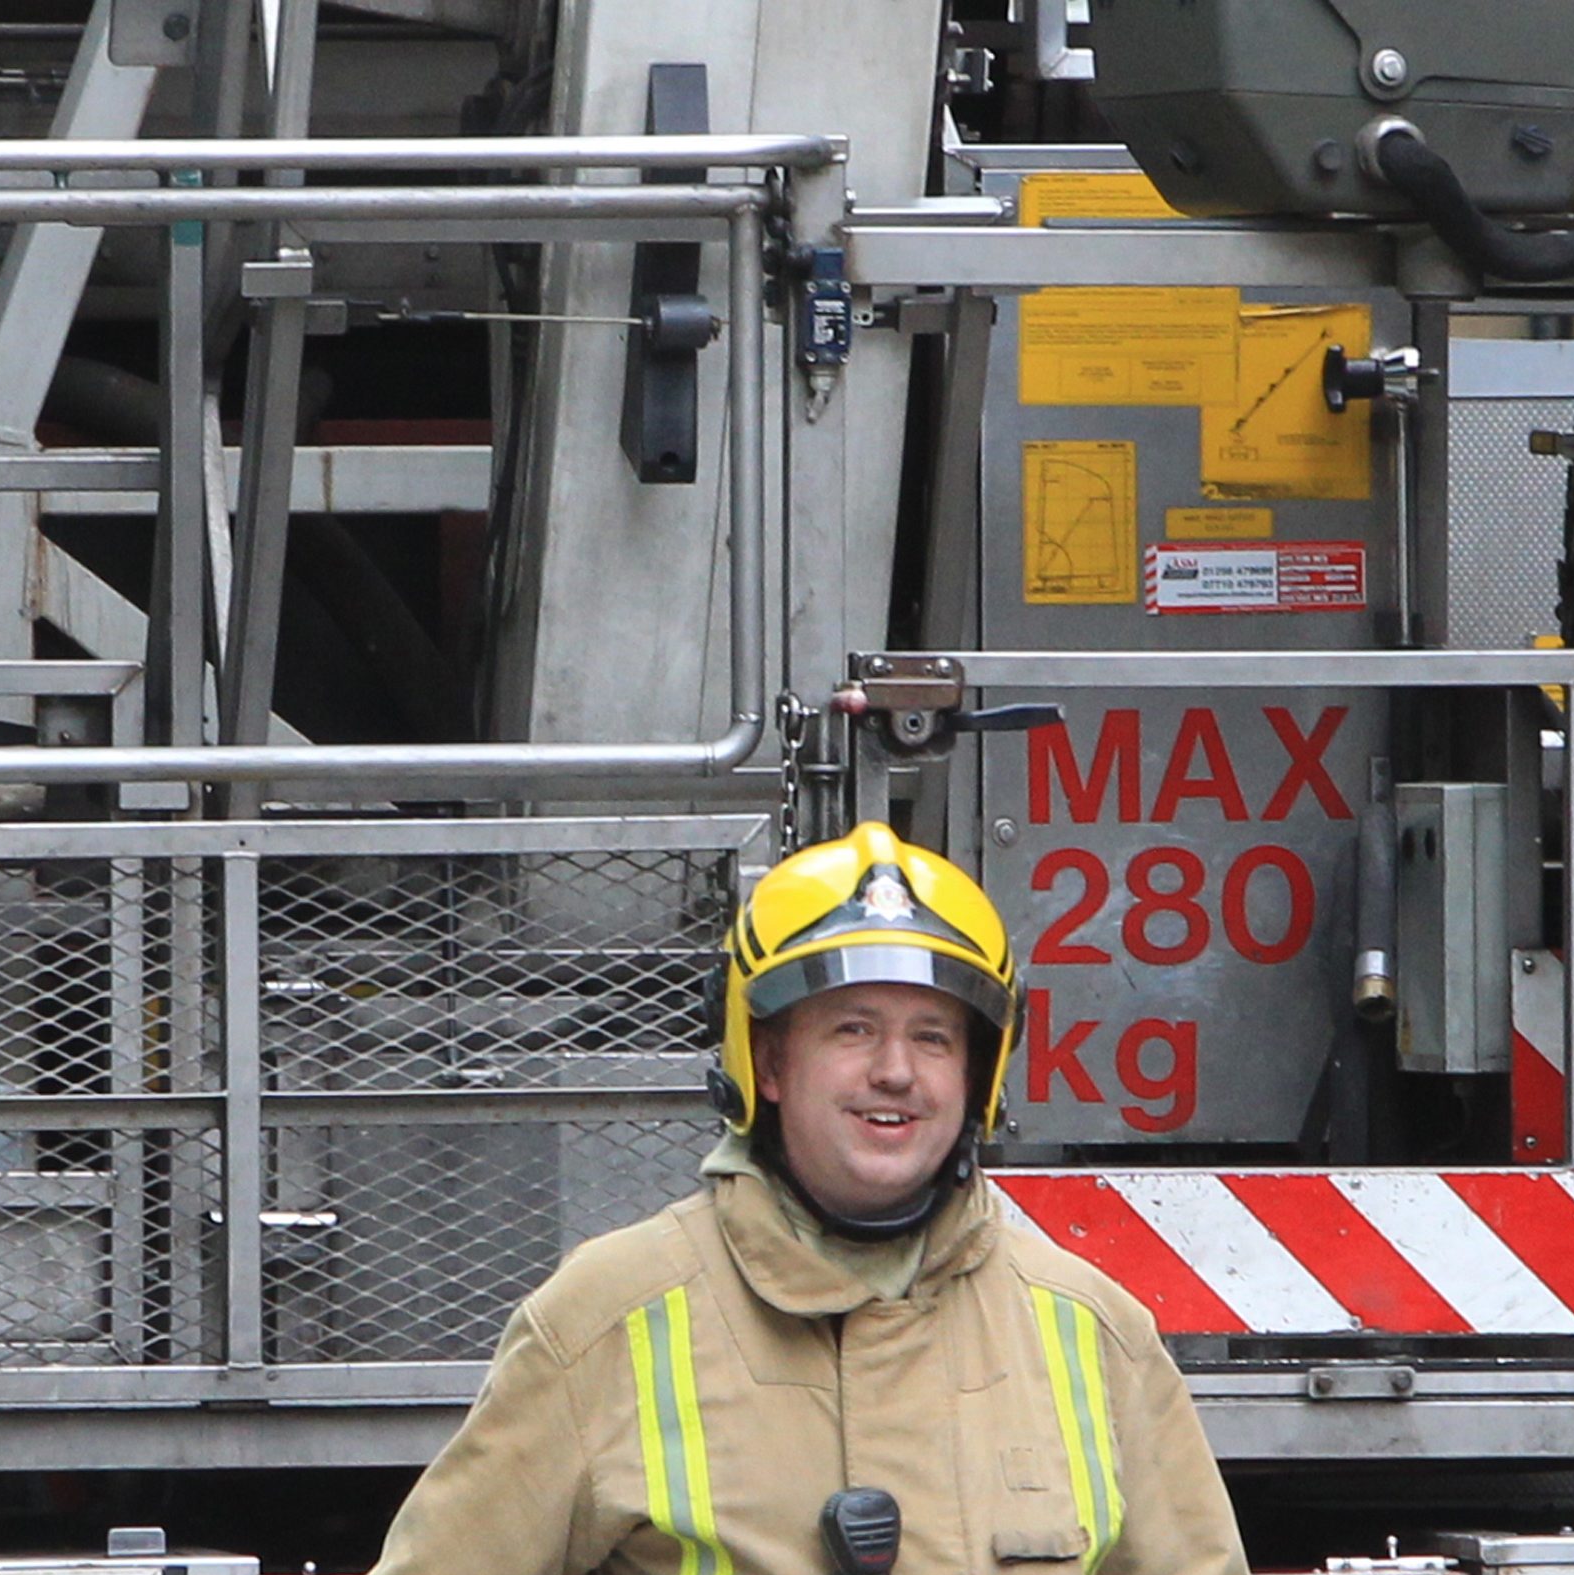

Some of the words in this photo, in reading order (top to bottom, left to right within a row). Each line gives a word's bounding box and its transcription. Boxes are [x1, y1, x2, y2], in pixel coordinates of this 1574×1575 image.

[1028, 706, 1355, 824] MAX
[1030, 844, 1316, 966] 280
[1027, 988, 1198, 1133] kg
